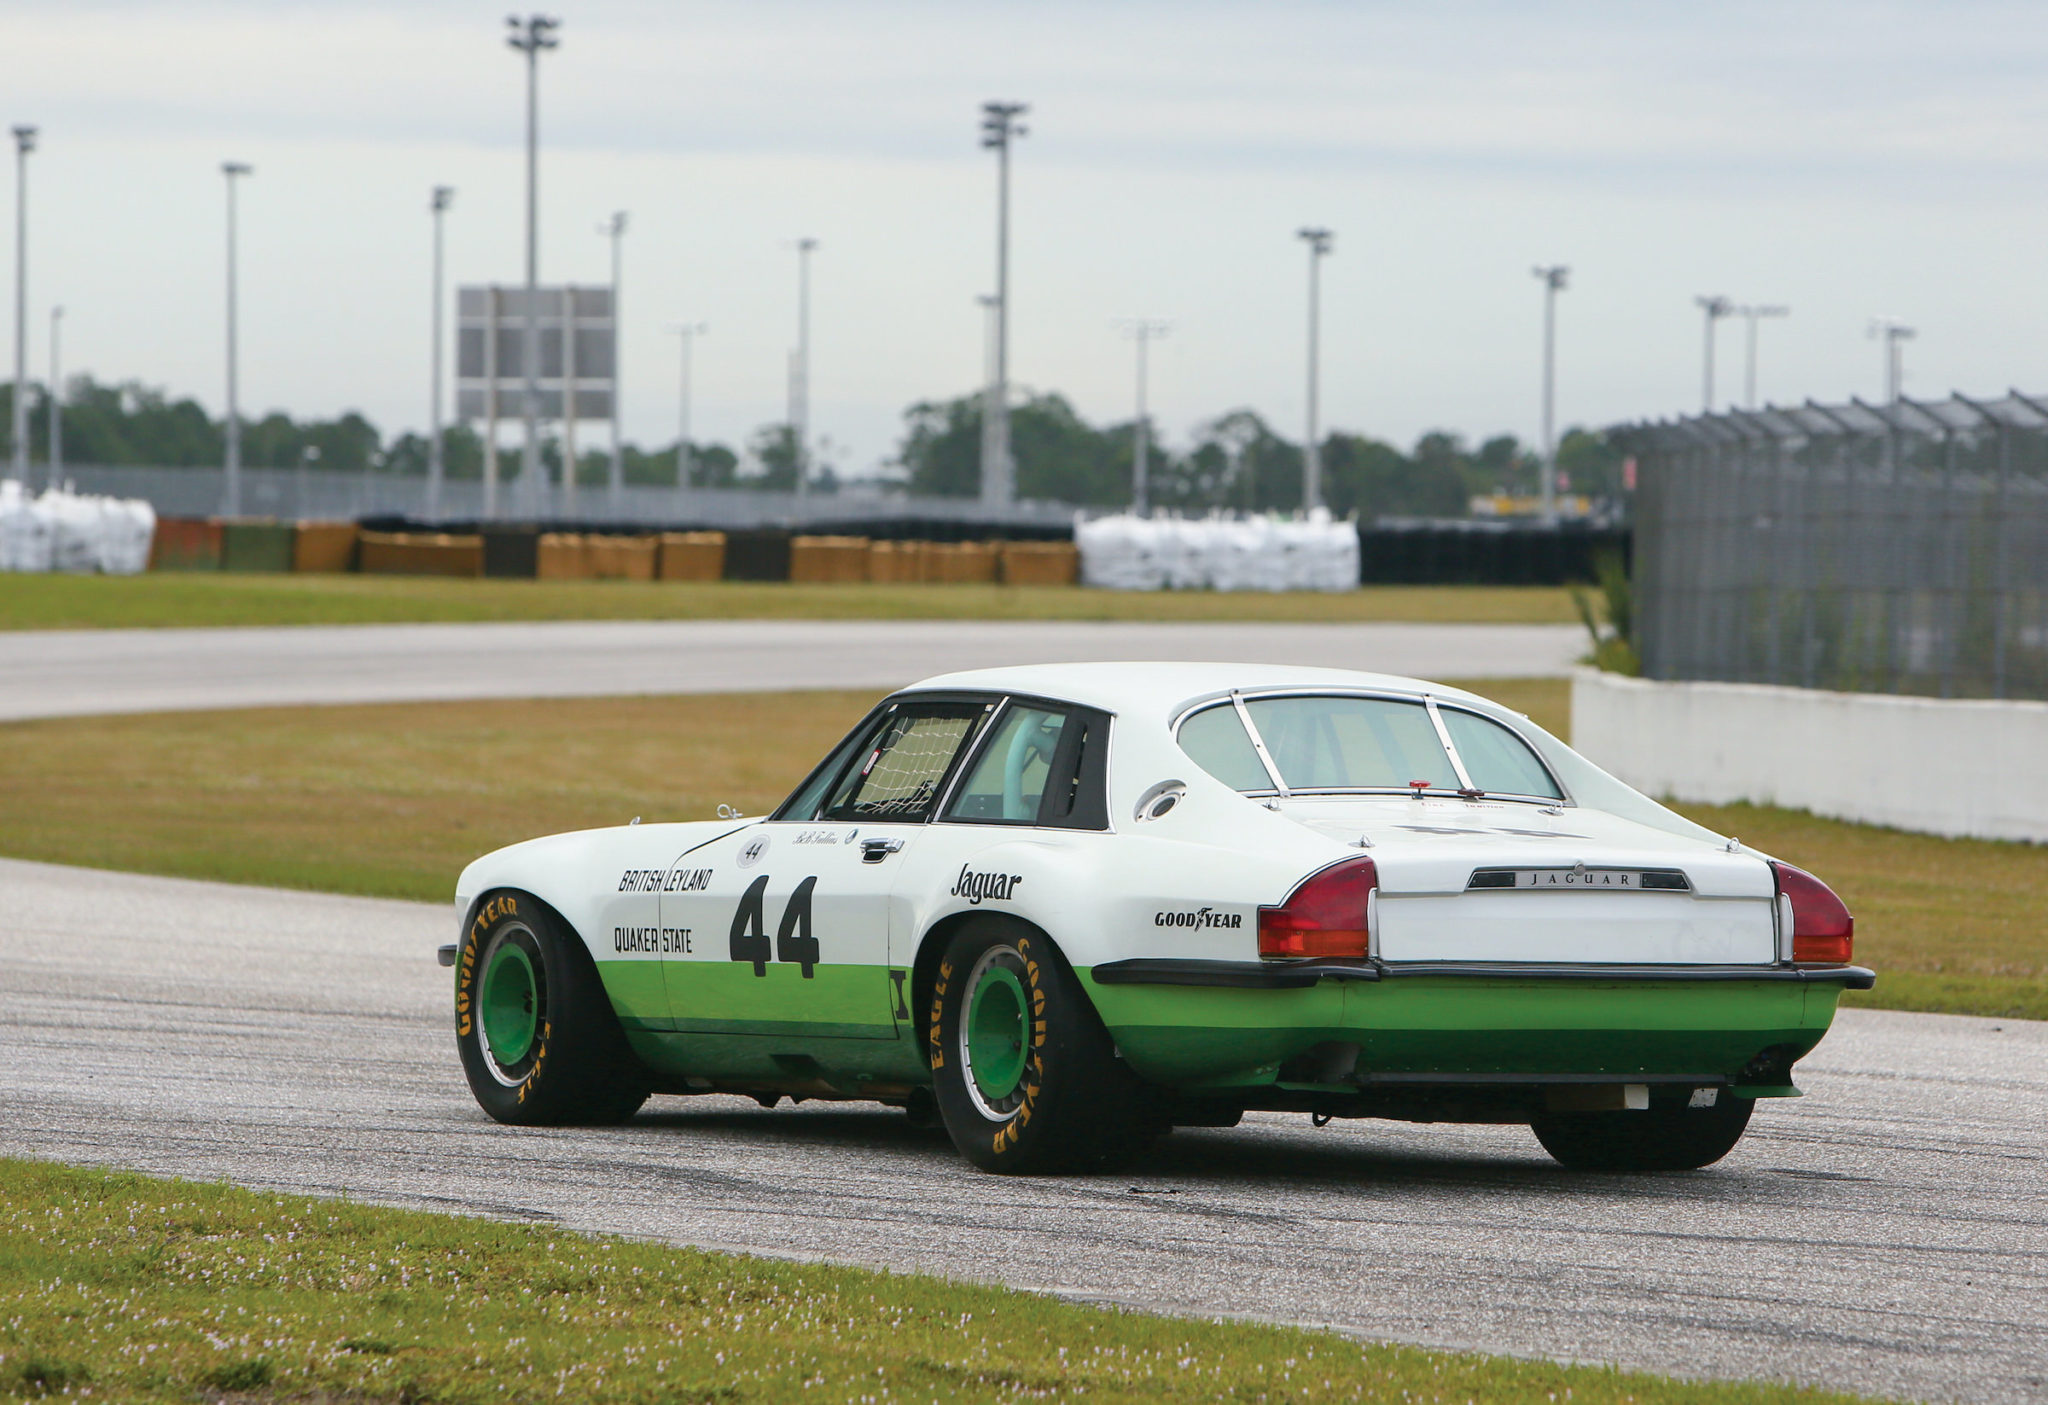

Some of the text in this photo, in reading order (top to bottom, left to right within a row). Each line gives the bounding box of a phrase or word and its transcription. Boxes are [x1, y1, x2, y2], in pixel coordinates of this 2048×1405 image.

[744, 842, 763, 860] 44
[618, 868, 713, 892] BRITISH LEYLAND
[950, 862, 1023, 905] Jaguar
[1531, 873, 1630, 886] JAGUAR
[614, 926, 693, 954] QUAKER STATE
[729, 874, 820, 979] 44
[930, 955, 953, 1071] EAGLE
